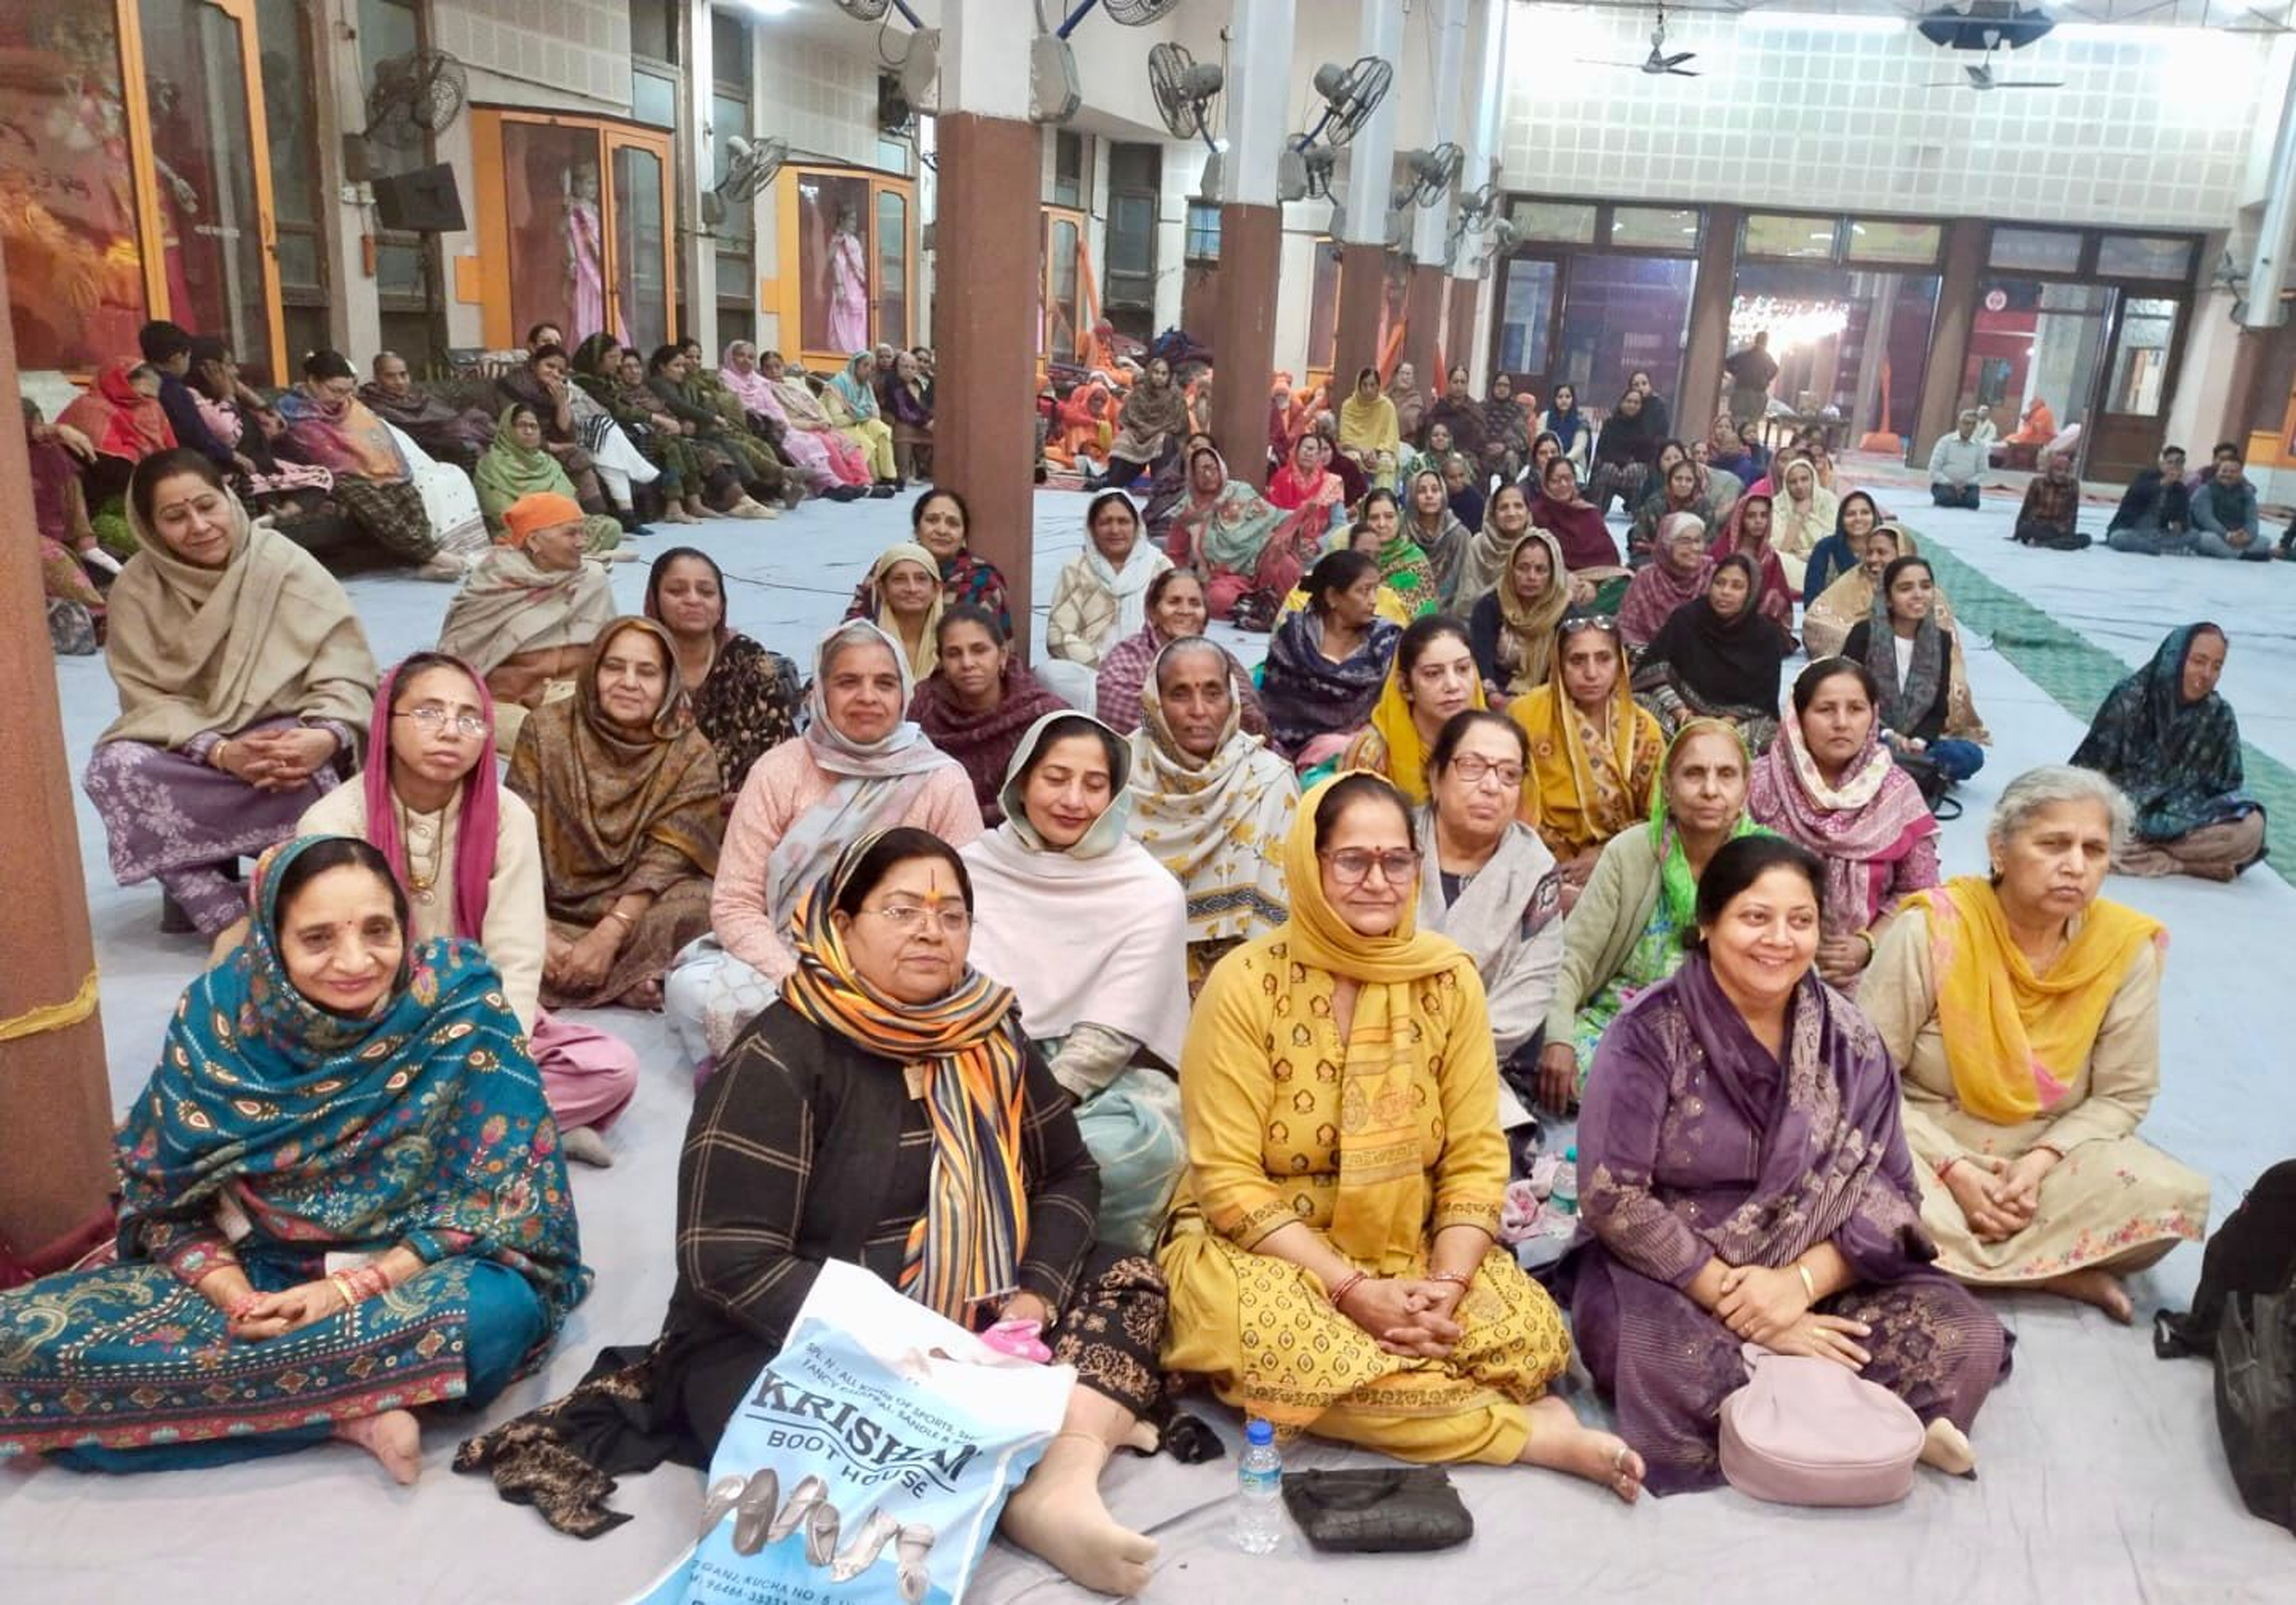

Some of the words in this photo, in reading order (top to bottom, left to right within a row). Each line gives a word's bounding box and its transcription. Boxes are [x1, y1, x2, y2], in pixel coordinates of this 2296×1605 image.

[838, 1371, 858, 1388] ALL
[896, 1397, 911, 1409] OF
[766, 1429, 842, 1461] BOOT
[840, 1464, 928, 1499] HOUSE
[743, 1575, 788, 1596] KUCHA
